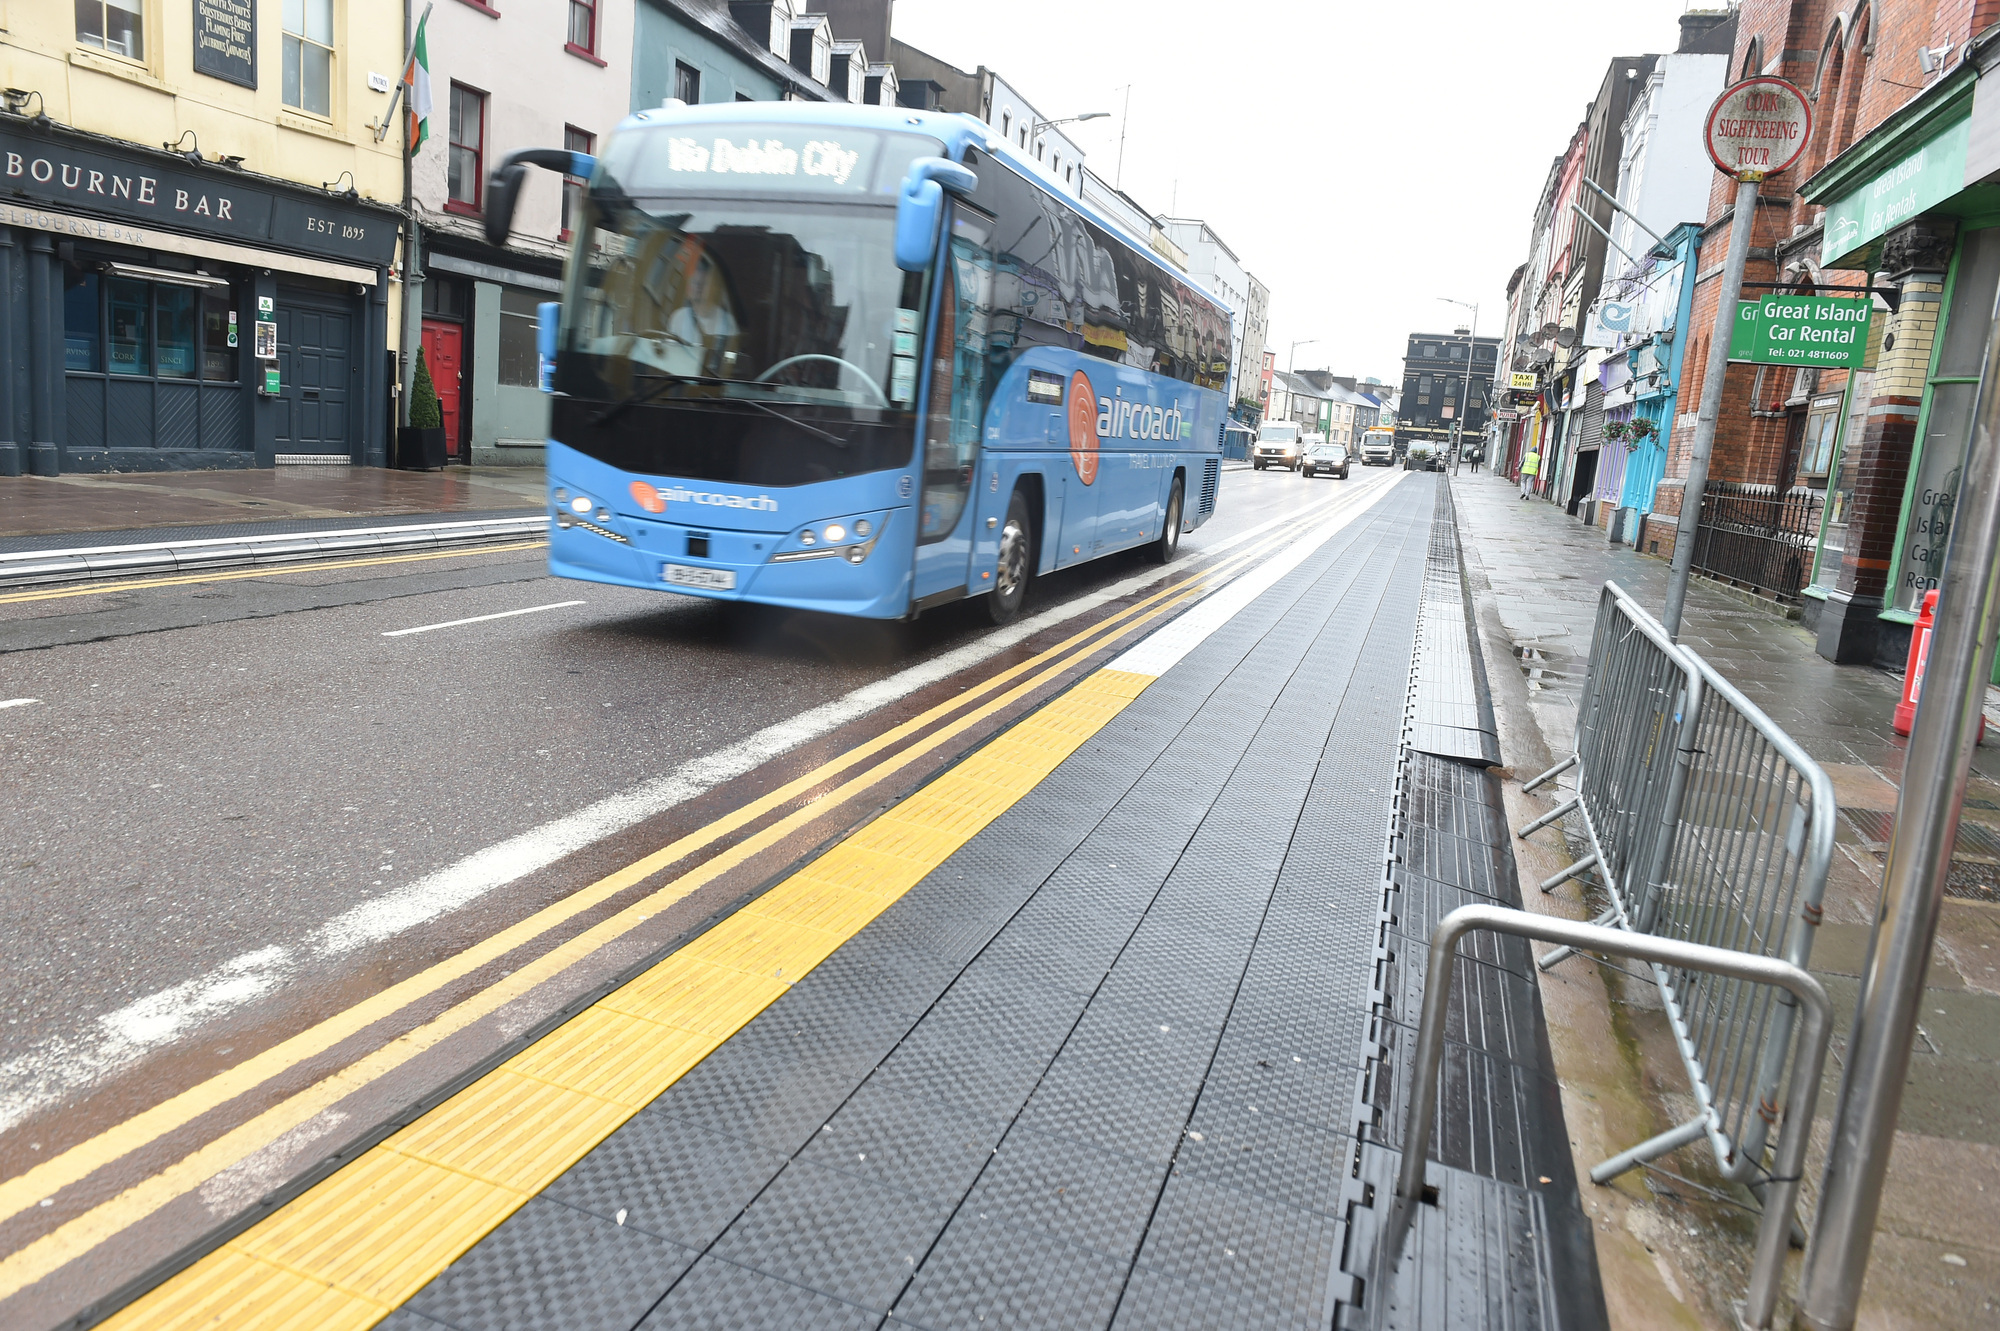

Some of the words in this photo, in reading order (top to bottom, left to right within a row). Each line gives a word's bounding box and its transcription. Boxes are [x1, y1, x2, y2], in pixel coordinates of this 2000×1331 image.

[199, 1, 234, 26] BOISTEROUS
[233, 14, 252, 32] BEERS
[205, 16, 231, 39] FLAMING
[1746, 93, 1780, 112] CORK
[1717, 118, 1799, 140] SIGHTSEEING
[710, 138, 799, 176] Dublin
[802, 140, 860, 185] City
[1737, 146, 1770, 166] TOUR
[1873, 167, 1895, 199] Great
[1896, 146, 1925, 185] Island
[6, 151, 157, 205] BOURNE
[175, 188, 233, 220] BAR
[1870, 210, 1884, 233] Car
[1884, 187, 1917, 225] Rentals
[113, 226, 144, 244] BAR
[307, 217, 335, 235] EST
[342, 225, 365, 241] 1895
[1764, 302, 1811, 320] Great
[1814, 303, 1868, 322] Island
[1768, 324, 1796, 341] Car
[1799, 325, 1857, 344] Rental
[112, 351, 136, 362] CORK
[1768, 348, 1785, 357] Tel:
[1787, 349, 1805, 358] 021
[1807, 350, 1849, 360] 4811609
[1513, 380, 1532, 388] 24HR
[1514, 373, 1533, 381] TAXI
[1095, 385, 1183, 441] aircoach
[656, 486, 778, 512] aircoach
[1911, 544, 1937, 563] Car
